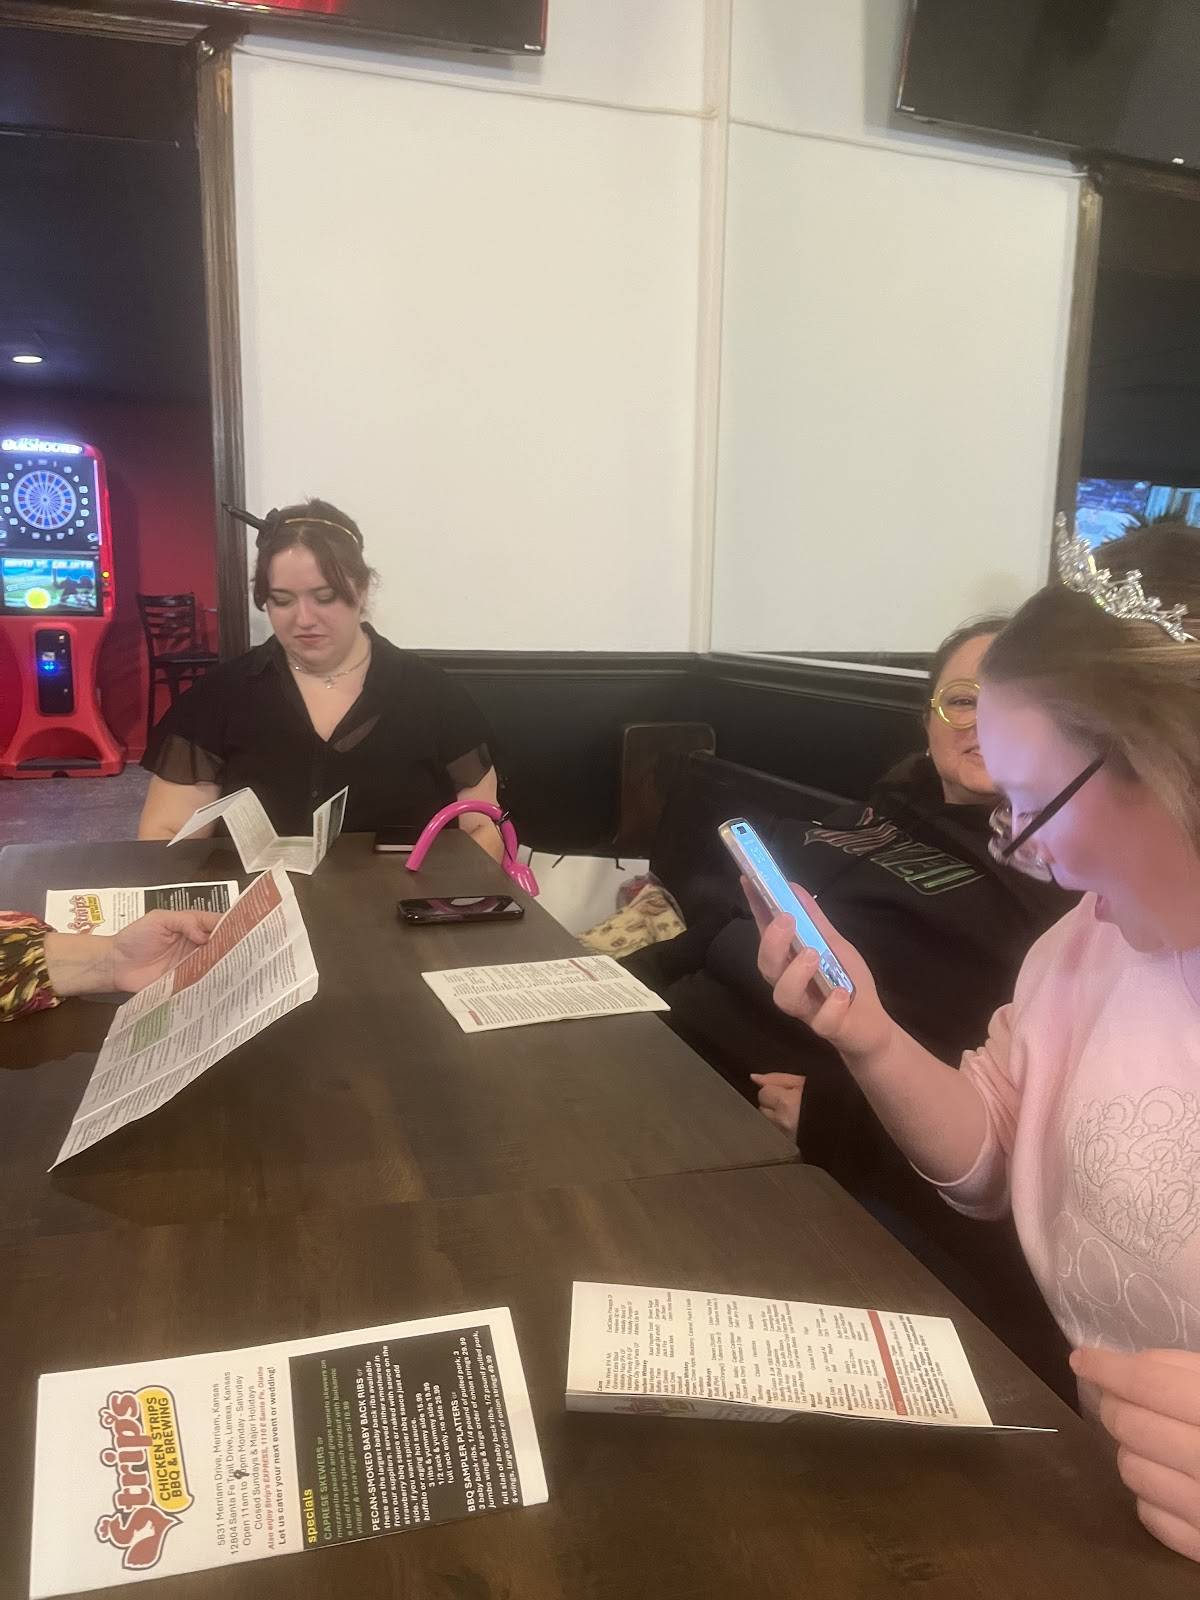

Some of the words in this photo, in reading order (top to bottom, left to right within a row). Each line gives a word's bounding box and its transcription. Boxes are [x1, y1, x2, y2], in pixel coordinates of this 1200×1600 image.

[384, 1358, 389, 1366] on
[454, 1356, 463, 1374] pork,
[463, 1356, 473, 1379] strings
[475, 1348, 485, 1370] pulled
[223, 1371, 231, 1400] Kansas
[267, 1366, 277, 1404] wedding!
[356, 1377, 365, 1397] RIBS
[365, 1361, 374, 1393] available
[374, 1362, 384, 1401] smothered
[457, 1374, 467, 1397] pulled
[480, 1370, 489, 1393] pound
[490, 1374, 499, 1397] strings
[211, 1383, 219, 1412] Kansas
[234, 1375, 245, 1411] Saturday
[468, 1380, 476, 1399] onion
[247, 1385, 257, 1420] Holidays
[271, 1406, 276, 1415] or
[358, 1399, 368, 1424] BACK
[379, 1402, 387, 1424] either
[436, 1405, 444, 1420] side
[494, 1398, 503, 1418] onion
[147, 1396, 161, 1441] STRIPS
[158, 1397, 176, 1454] BREWING
[390, 1407, 398, 1430] naked
[400, 1417, 408, 1431] bbq
[440, 1422, 445, 1430] no
[451, 1400, 464, 1442] PLATTERS
[463, 1406, 473, 1429] pound
[472, 1409, 481, 1429] order
[498, 1419, 504, 1427] of
[236, 1418, 246, 1451] Monday
[249, 1423, 258, 1446] Major
[361, 1426, 371, 1450] BABY
[373, 1428, 382, 1447] baby
[382, 1425, 391, 1450] served
[394, 1431, 399, 1439] or
[422, 1429, 431, 1456] yummy
[430, 1418, 439, 1445] yummy
[476, 1430, 486, 1449] large
[489, 1423, 498, 1441] back
[500, 1428, 508, 1448] order
[272, 1444, 280, 1463] next
[402, 1432, 412, 1457] spicier
[469, 1444, 478, 1461] ribs,
[493, 1442, 503, 1461] baby
[167, 1457, 177, 1467] &
[214, 1454, 223, 1480] Drive,
[316, 1446, 327, 1492] SKEWERS
[375, 1448, 385, 1474] largest
[406, 1459, 414, 1477] want
[416, 1455, 426, 1480] raging
[434, 1454, 442, 1470] rack
[458, 1444, 472, 1488] SAMPLER
[481, 1457, 491, 1480] wings
[496, 1462, 503, 1471] of
[504, 1449, 513, 1469] large
[99, 1392, 173, 1567] Strip's
[153, 1443, 170, 1501] CHICKEN
[251, 1457, 261, 1495] Sundays
[397, 1464, 405, 1479] bbq
[426, 1465, 434, 1480] ribs
[446, 1470, 454, 1483] full
[472, 1462, 480, 1481] back
[498, 1472, 506, 1489] slab
[168, 1470, 182, 1498] BBQ
[227, 1484, 235, 1495] Fe
[240, 1481, 247, 1489] to
[364, 1452, 380, 1530] PECAN-SMOKED
[420, 1481, 426, 1489] or
[476, 1482, 485, 1502] baby
[484, 1481, 496, 1508] jumbo
[215, 1482, 224, 1520] Merriam
[240, 1492, 248, 1516] 11am
[399, 1480, 412, 1524] strawberry
[420, 1491, 430, 1520] buffalo
[465, 1490, 477, 1511] BBQ
[501, 1491, 509, 1504] full
[228, 1497, 237, 1524] Santa
[253, 1497, 262, 1529] Closed
[278, 1515, 284, 1526] us
[304, 1489, 318, 1543] specials
[320, 1493, 331, 1540] CAPRESE
[382, 1505, 390, 1528] these
[392, 1506, 400, 1526] from
[217, 1523, 225, 1545] 5831
[241, 1519, 251, 1546] Open
